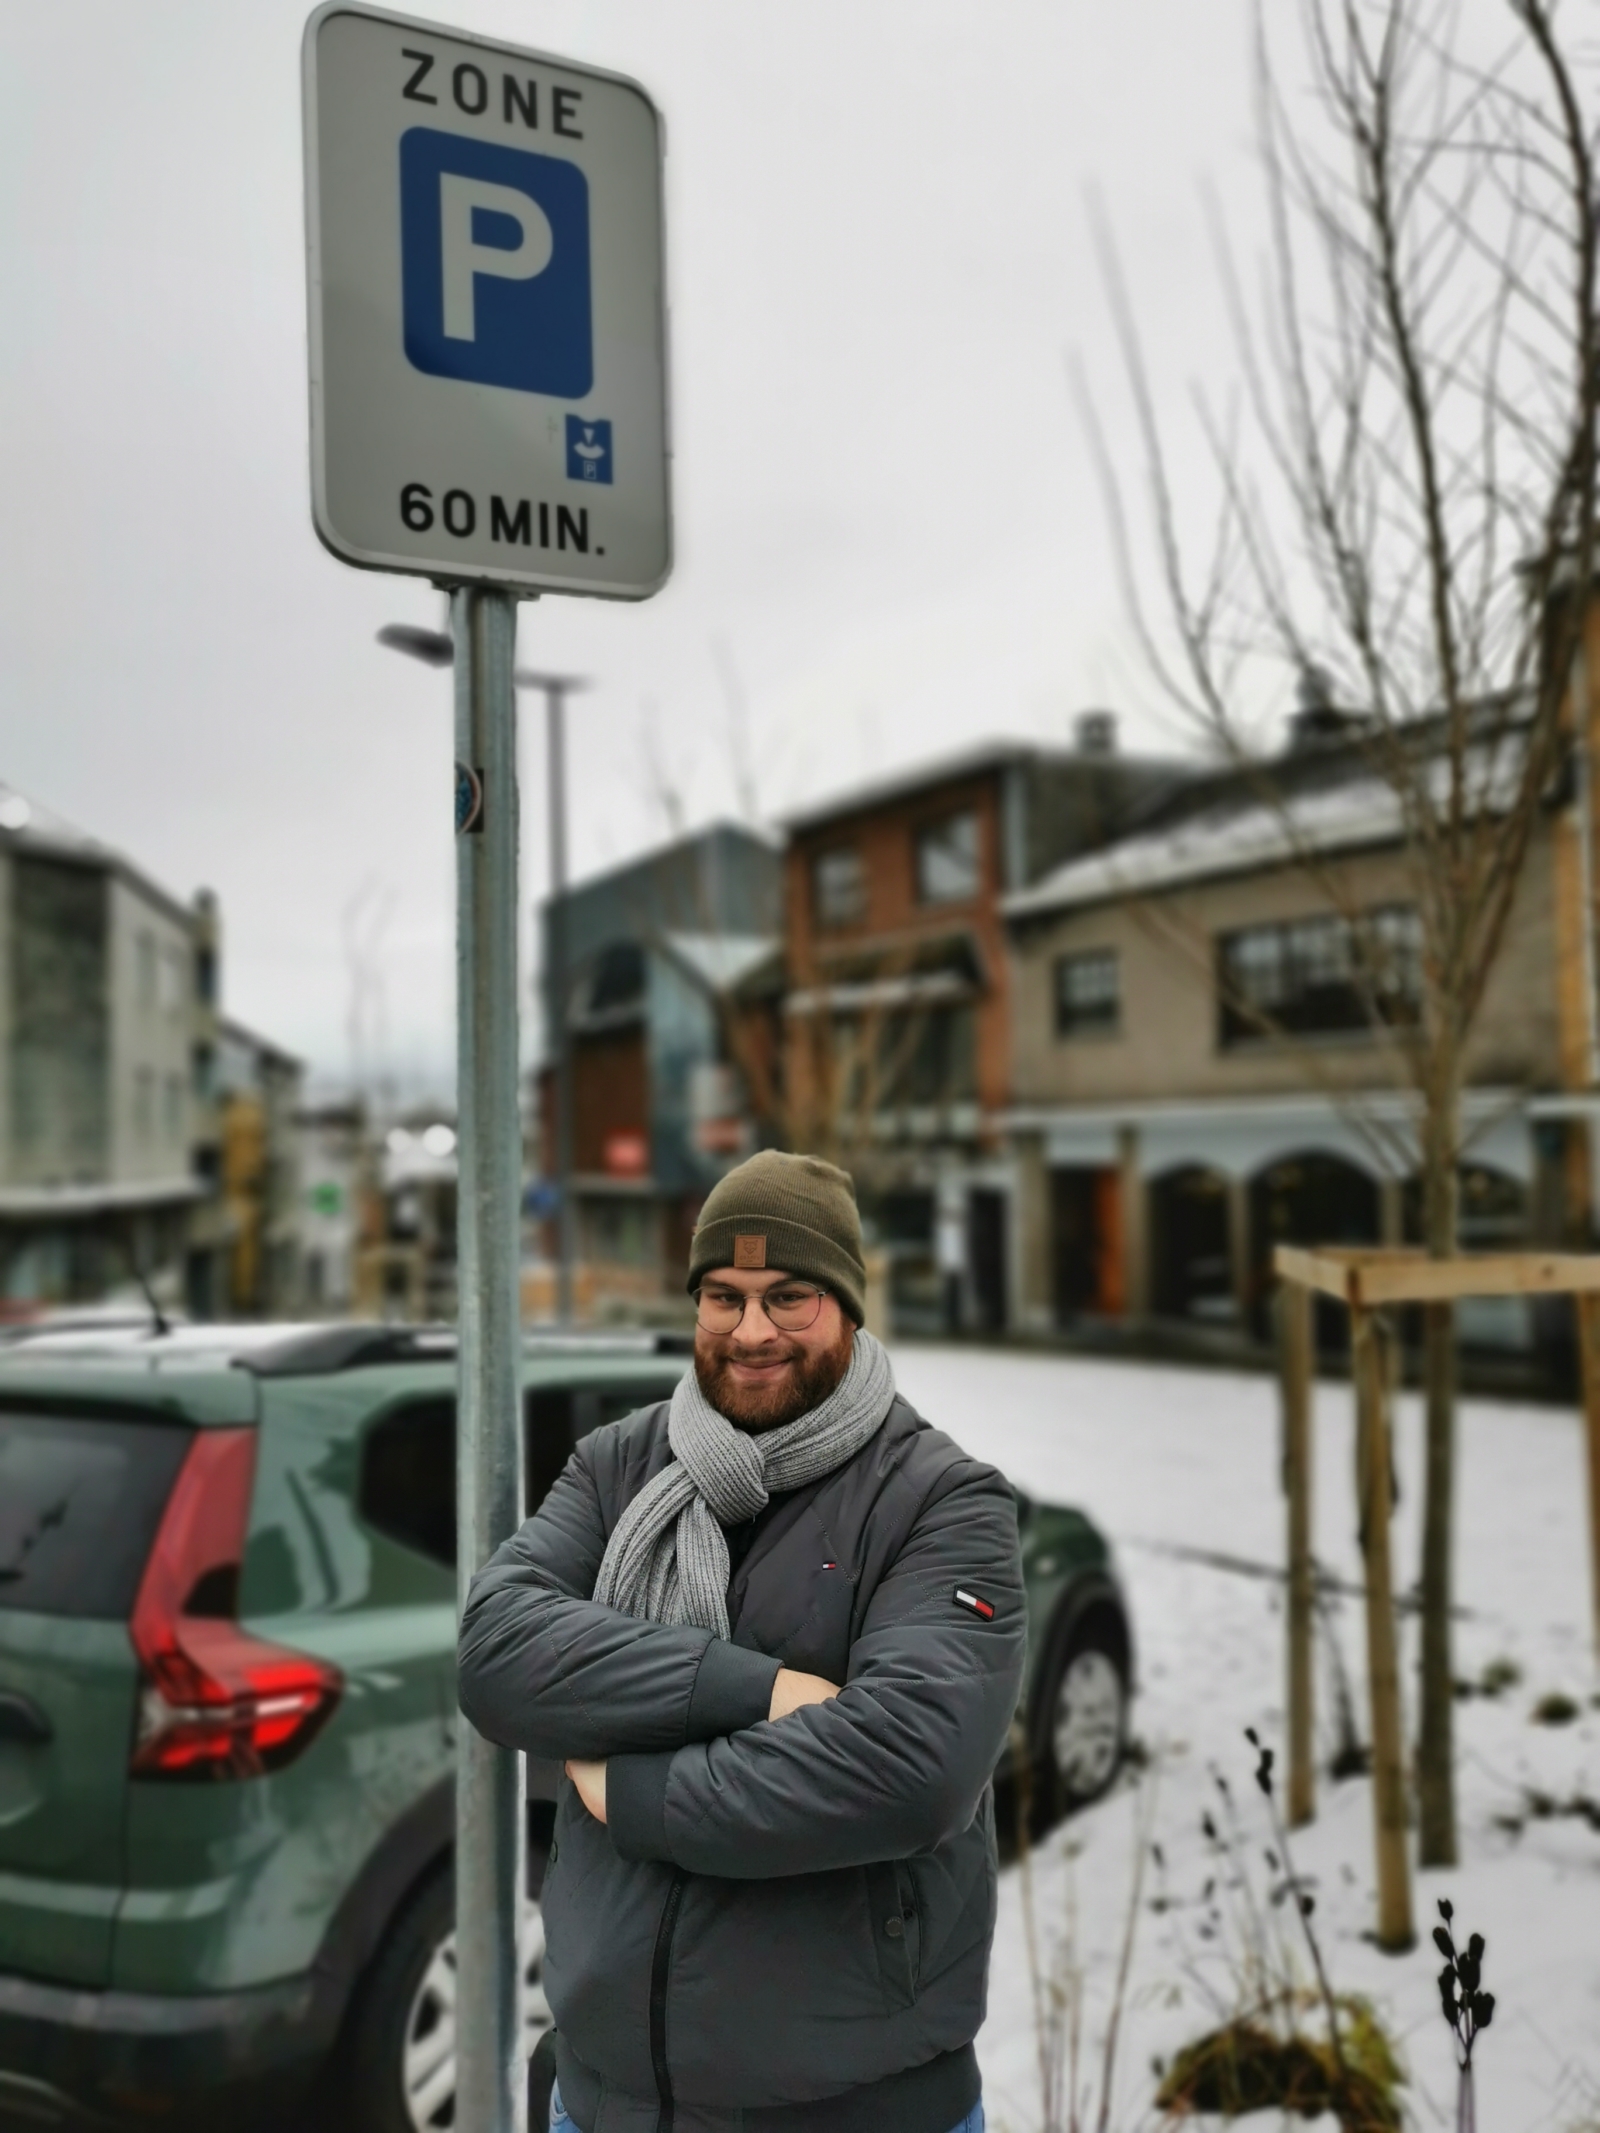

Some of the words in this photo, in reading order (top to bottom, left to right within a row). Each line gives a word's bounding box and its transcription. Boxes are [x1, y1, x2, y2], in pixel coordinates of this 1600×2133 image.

[402, 48, 583, 140] ZONE
[440, 171, 553, 342] P
[400, 483, 476, 538] 60
[490, 495, 605, 556] MIN.
